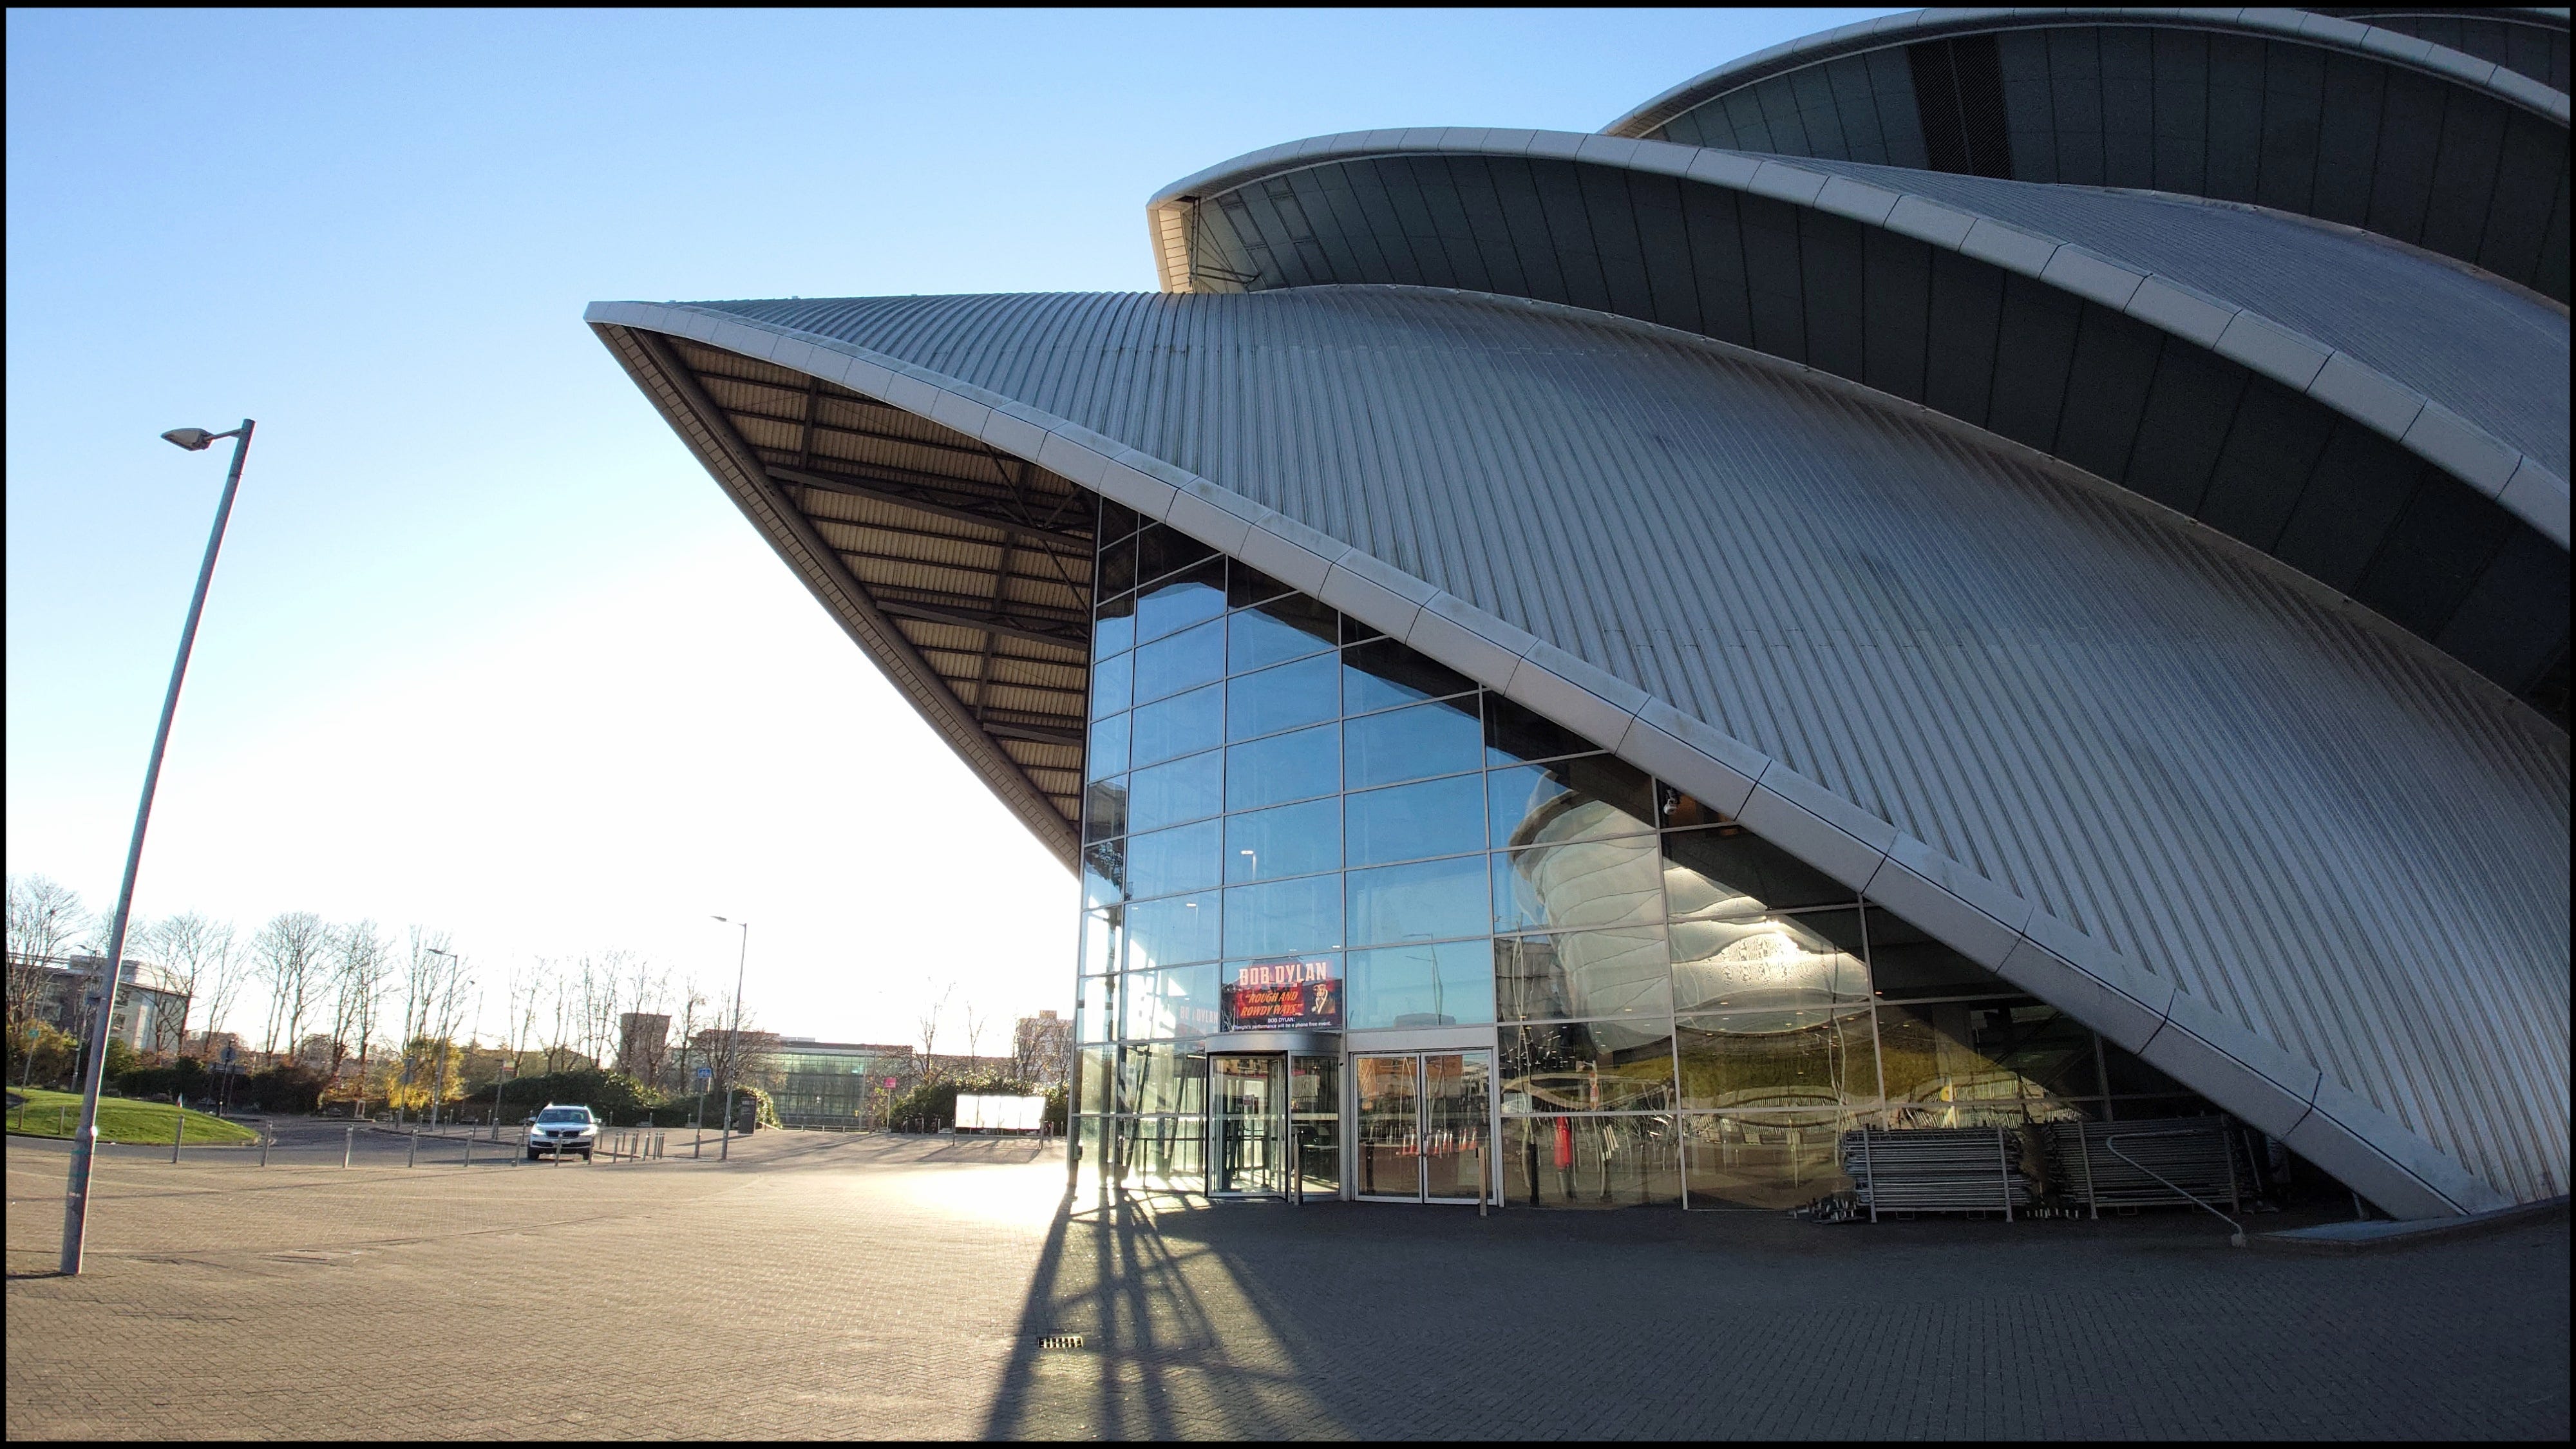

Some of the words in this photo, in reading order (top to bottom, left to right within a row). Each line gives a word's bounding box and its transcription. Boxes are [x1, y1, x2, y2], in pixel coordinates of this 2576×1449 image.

[1239, 967, 1270, 986] BOB
[1275, 962, 1327, 984] DYLAN
[1278, 991, 1298, 1001] AND
[1240, 1005, 1273, 1016] ROWDY
